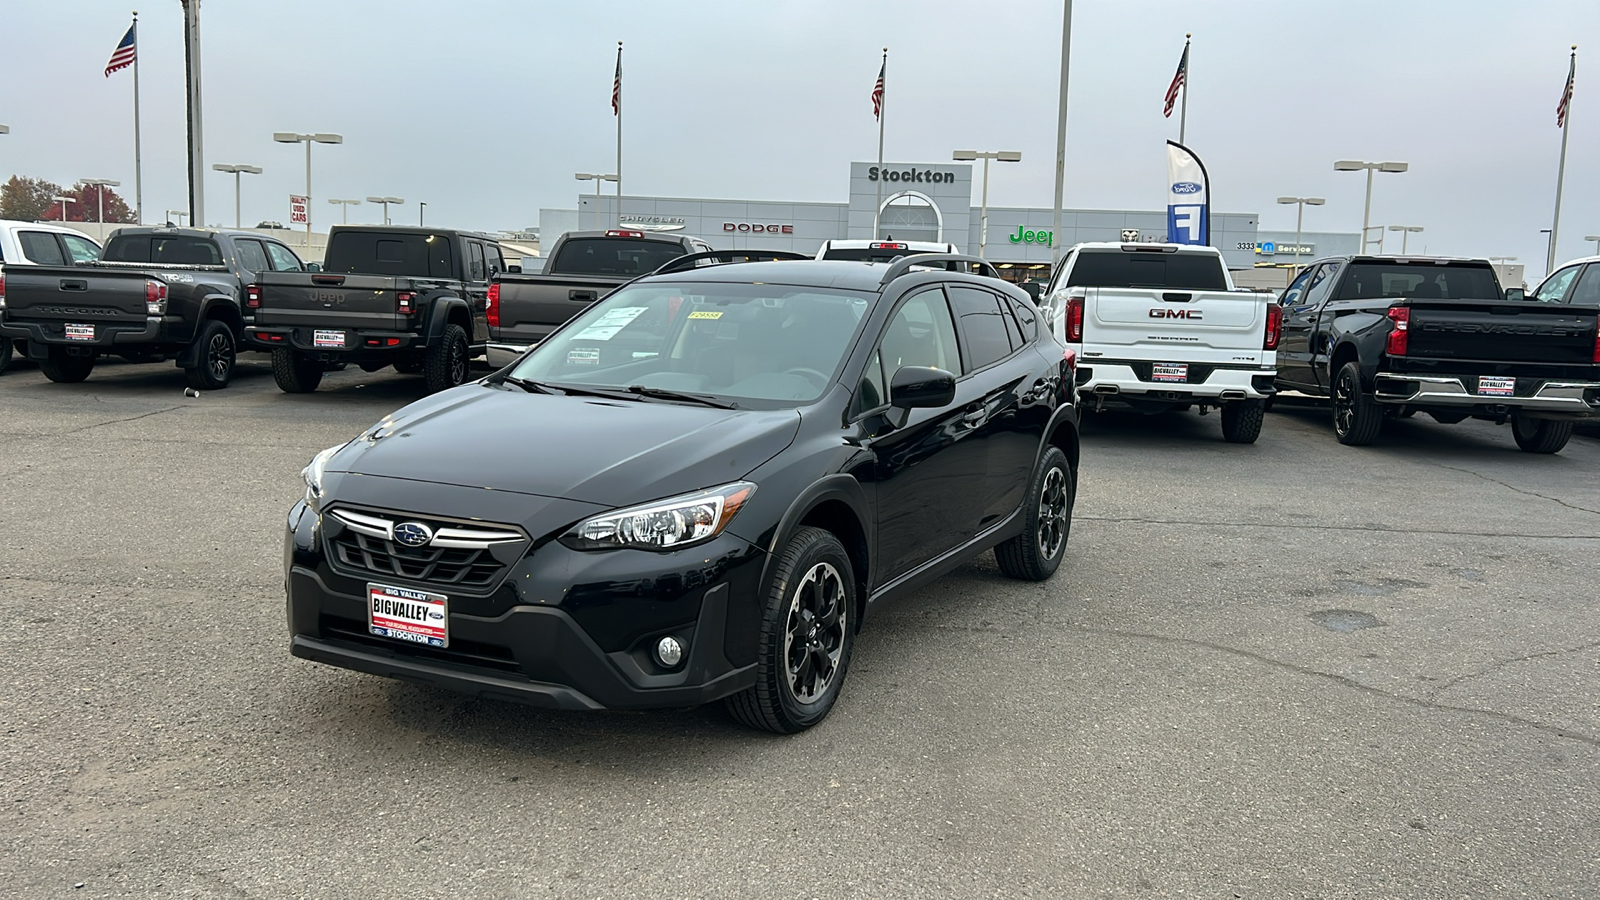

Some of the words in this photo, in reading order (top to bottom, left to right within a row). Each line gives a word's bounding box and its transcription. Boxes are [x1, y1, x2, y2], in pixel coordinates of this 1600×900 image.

[868, 166, 955, 184] Stockton
[293, 205, 305, 213] USED
[292, 213, 307, 222] CARS
[619, 214, 685, 224] CHRYSLER
[723, 222, 794, 234] DODGE
[1236, 242, 1255, 250] 3333
[1277, 244, 1312, 253] Servce
[309, 289, 346, 305] Jeep
[37, 306, 118, 316] TACOMA
[1149, 308, 1203, 320] GMC
[1422, 322, 1588, 337] CHEVROLET
[385, 588, 399, 596] BIG
[400, 590, 427, 600] VALLEY
[373, 597, 429, 621] BIGVALLEY
[387, 629, 429, 644] STOCKTON
